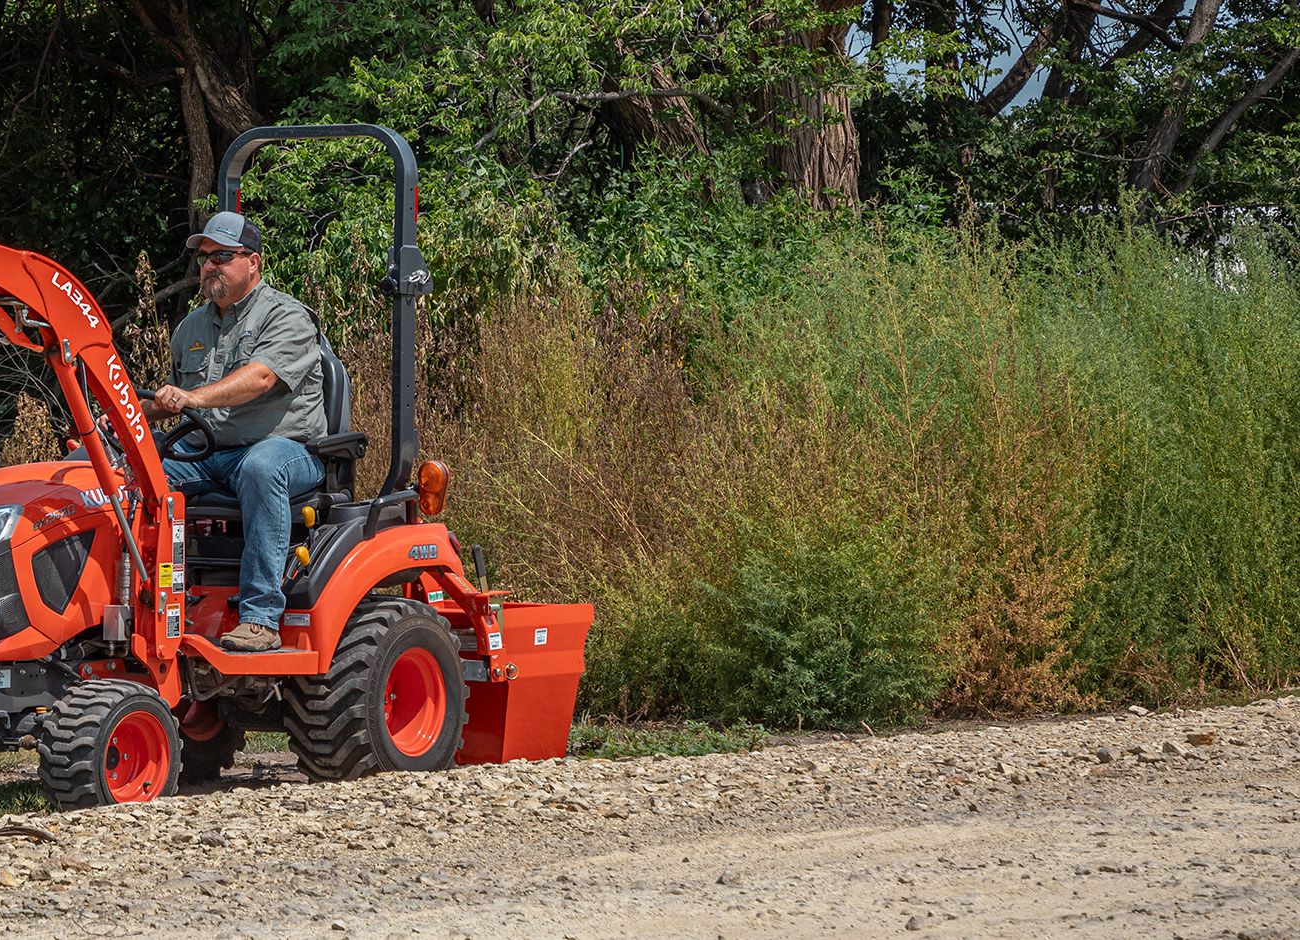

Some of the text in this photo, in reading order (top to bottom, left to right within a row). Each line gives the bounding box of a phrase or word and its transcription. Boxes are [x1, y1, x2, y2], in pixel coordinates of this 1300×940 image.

[51, 271, 99, 328] LA344
[107, 354, 145, 443] Kubota
[408, 544, 438, 560] 4WD
